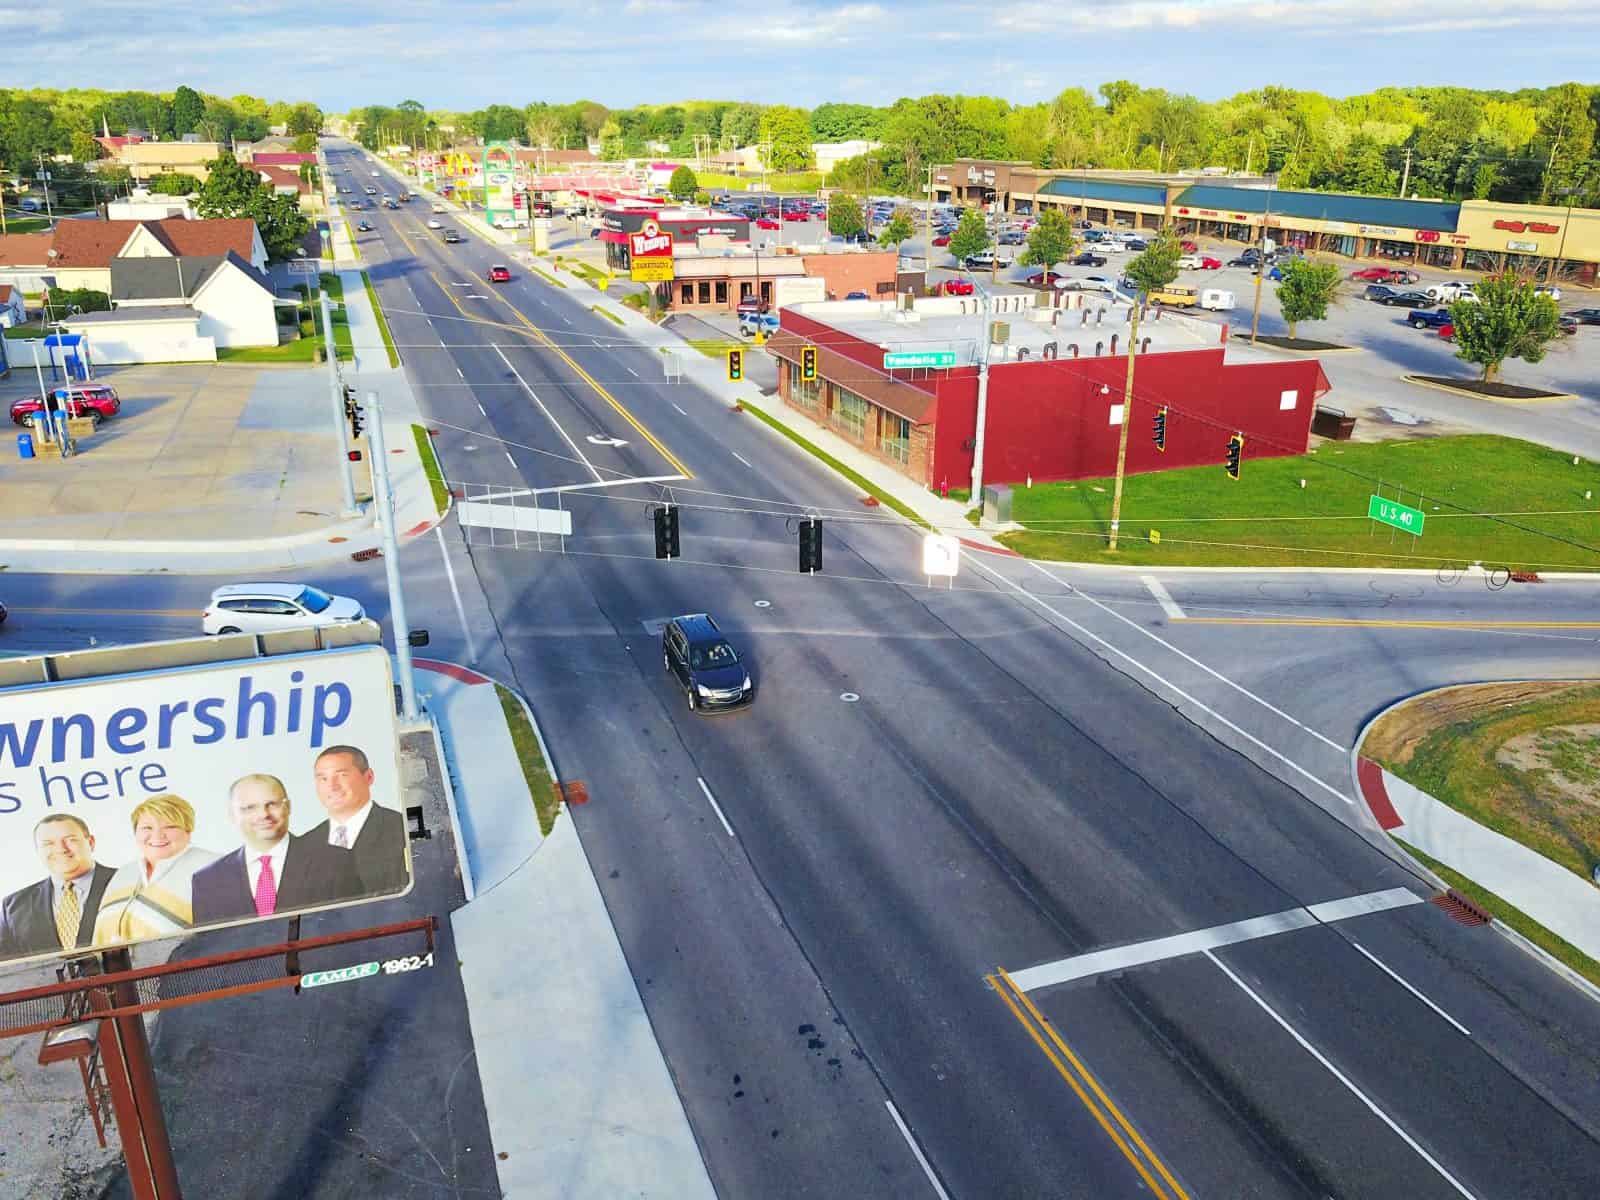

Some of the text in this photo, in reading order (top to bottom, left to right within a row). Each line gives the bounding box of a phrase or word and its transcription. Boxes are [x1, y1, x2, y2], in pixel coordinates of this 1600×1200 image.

[1400, 511, 1413, 526] 40
[39, 763, 168, 807] here
[306, 953, 434, 986] LAMAR 1962-1
